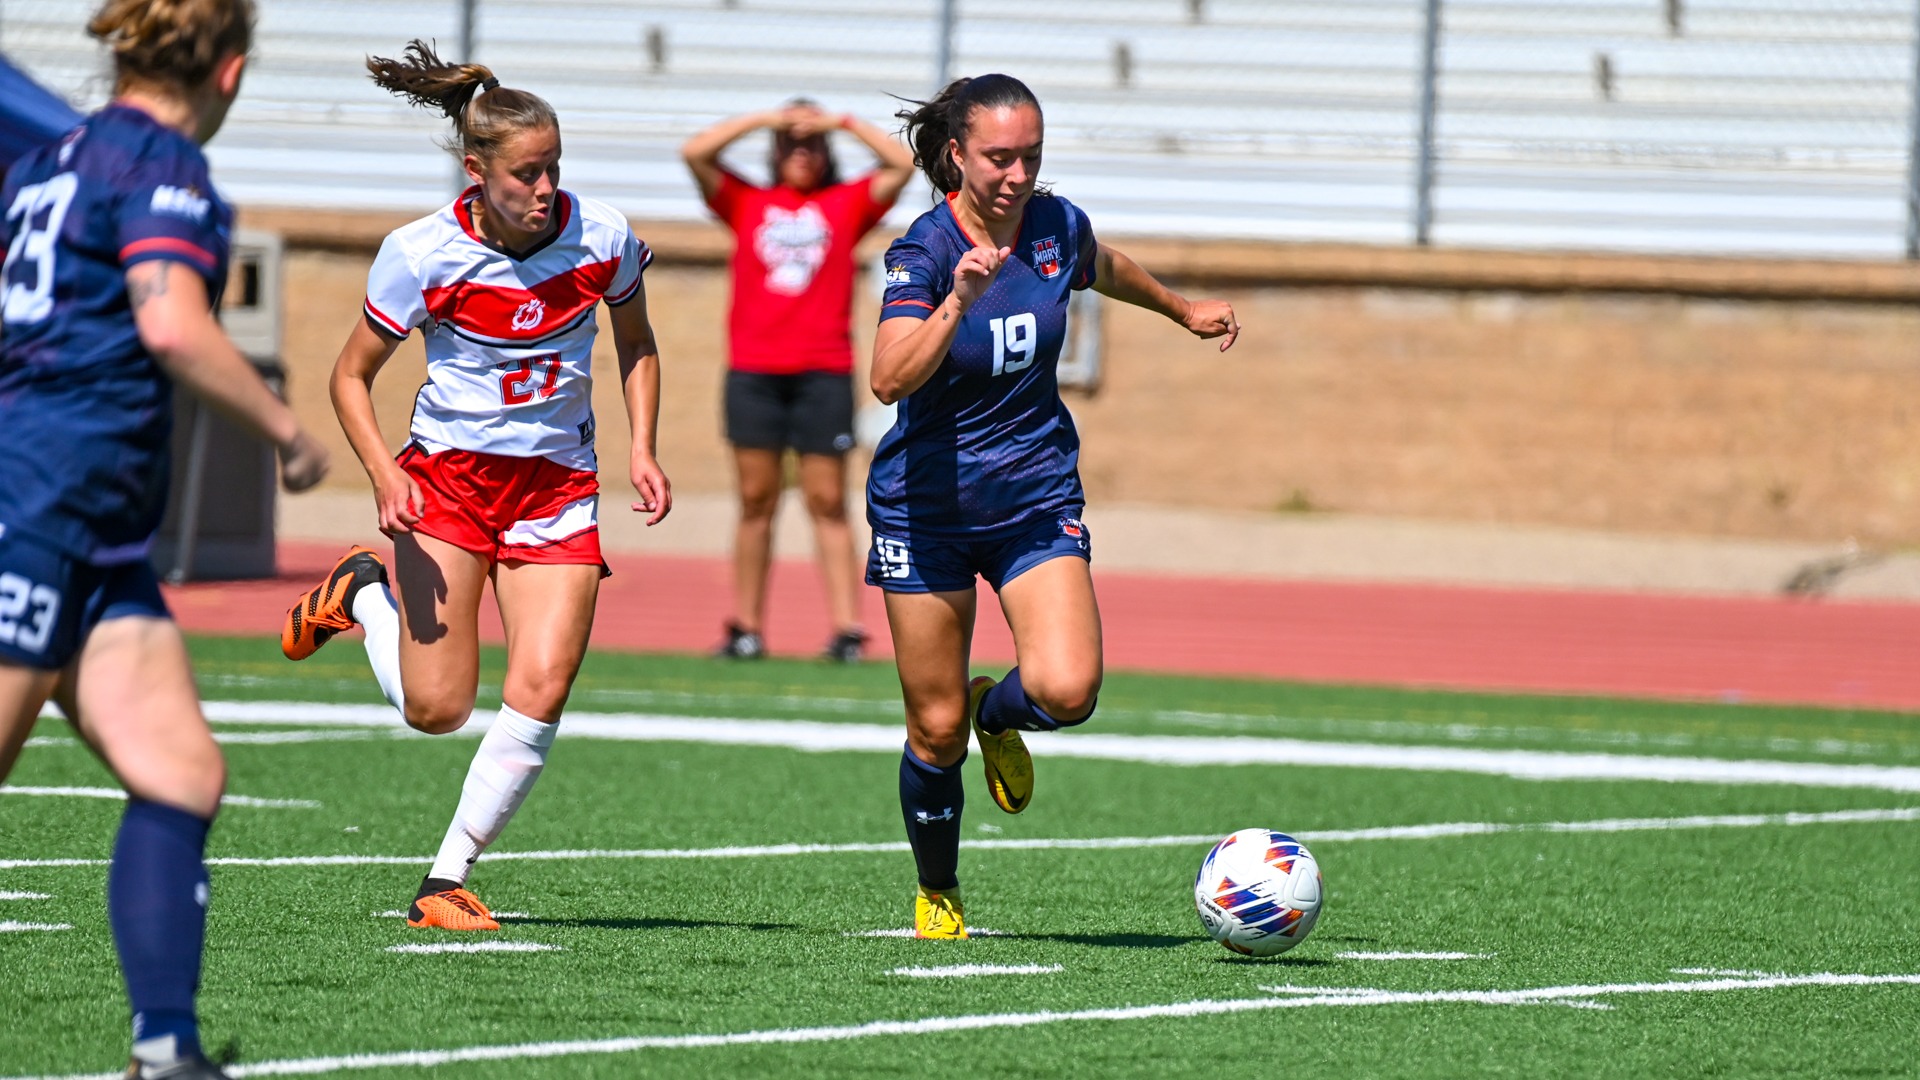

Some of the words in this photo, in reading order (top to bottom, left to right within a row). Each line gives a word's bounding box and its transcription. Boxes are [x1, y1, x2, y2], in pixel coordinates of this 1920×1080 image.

[0, 171, 78, 324] 23
[1034, 246, 1059, 266] MARY
[990, 312, 1037, 377] 19
[497, 352, 562, 405] 27
[876, 536, 909, 578] 19
[0, 571, 61, 654] 23
